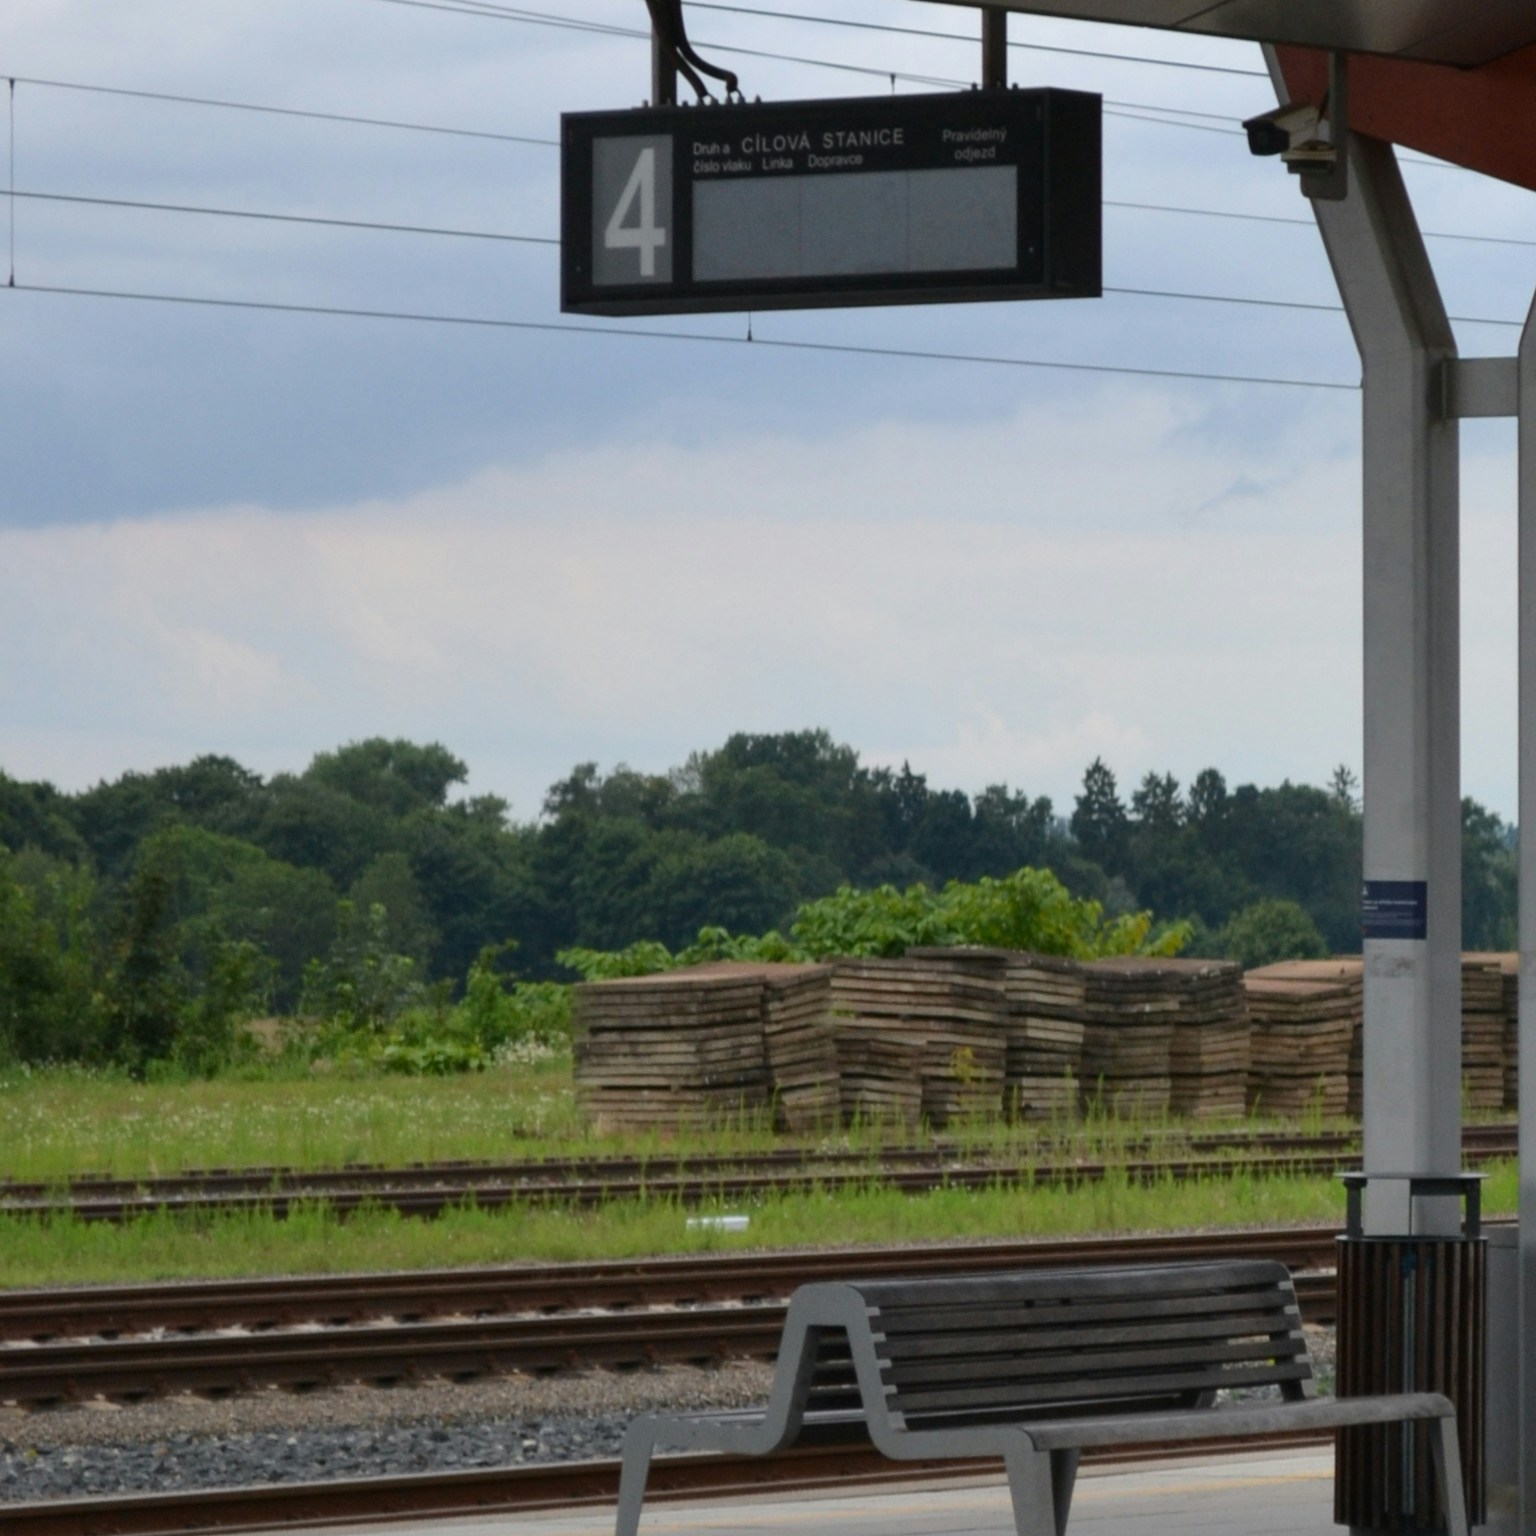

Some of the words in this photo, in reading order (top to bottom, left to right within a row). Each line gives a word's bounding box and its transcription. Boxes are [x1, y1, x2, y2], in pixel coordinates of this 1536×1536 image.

[693, 142, 720, 156] Druh
[722, 144, 731, 155] a
[741, 131, 811, 154] CÍLOVÁ
[822, 128, 905, 149] STANICE
[942, 127, 1008, 144] Pravidelný
[722, 157, 752, 172] vlaku
[762, 157, 794, 171] Linka
[808, 153, 864, 169] Dopravce
[954, 146, 997, 162] odjezd
[604, 147, 666, 277] 4
